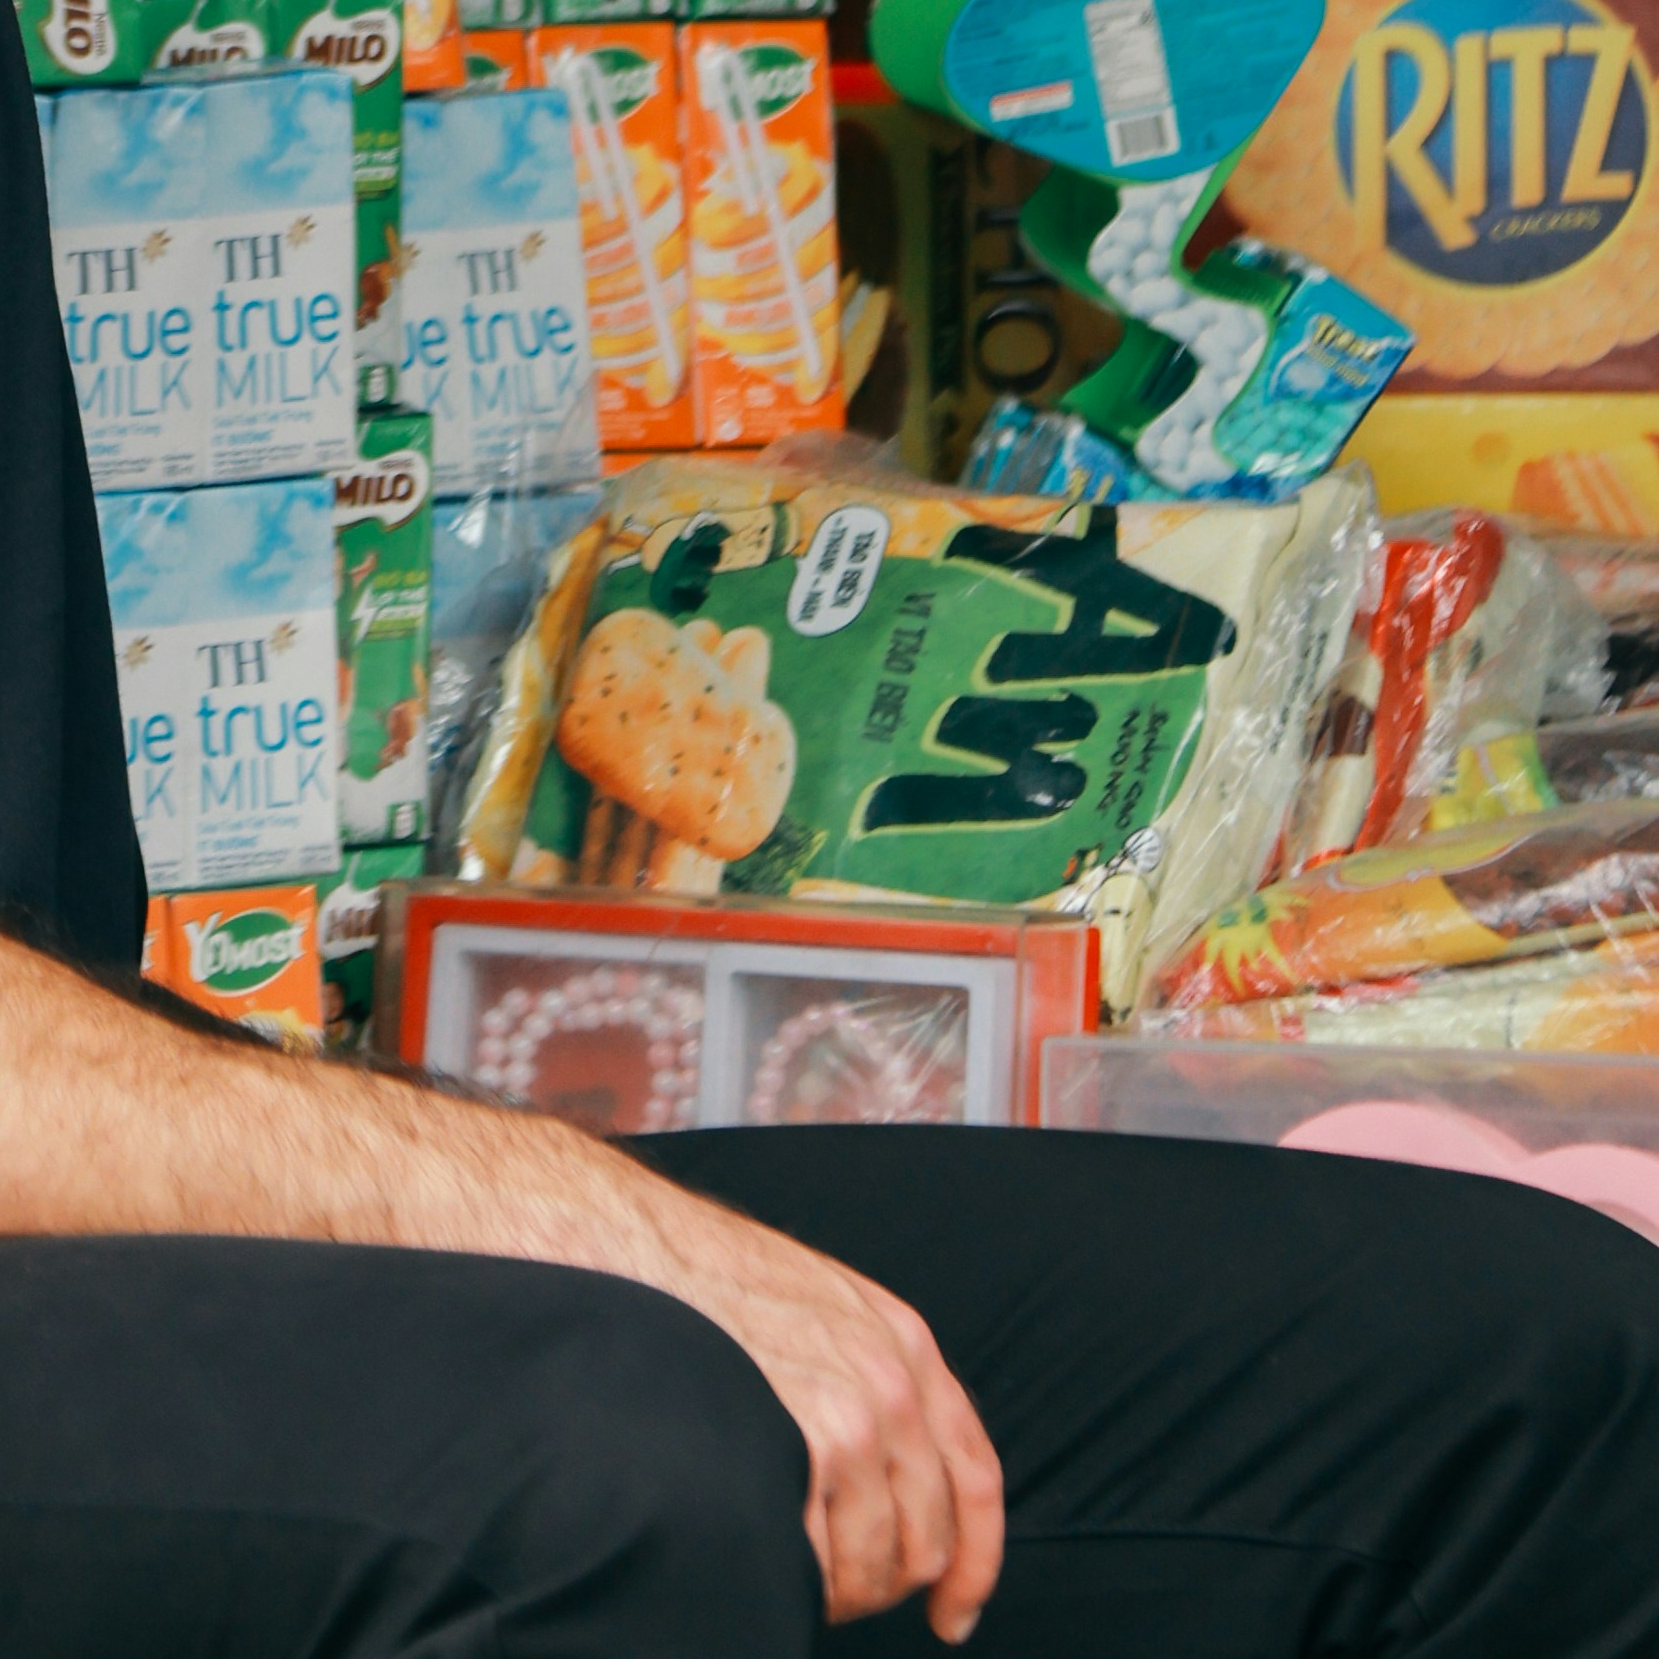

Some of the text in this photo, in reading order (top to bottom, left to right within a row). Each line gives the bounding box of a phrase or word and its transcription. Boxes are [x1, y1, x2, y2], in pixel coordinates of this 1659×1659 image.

[303, 32, 387, 66] MILO
[1352, 23, 1636, 253] RITZ
[1489, 205, 1602, 239] CRACKERS
[66, 247, 140, 298] TH
[213, 233, 285, 282] TH
[458, 247, 522, 297] TH
[63, 306, 194, 365] true
[213, 288, 341, 350] true
[461, 303, 576, 365] true
[76, 361, 195, 420] MILK
[213, 346, 341, 410] MILK
[470, 359, 578, 418] MILK
[334, 472, 415, 507] MILO
[196, 638, 268, 689] TH
[196, 694, 326, 759] true
[200, 750, 331, 814] MILK
